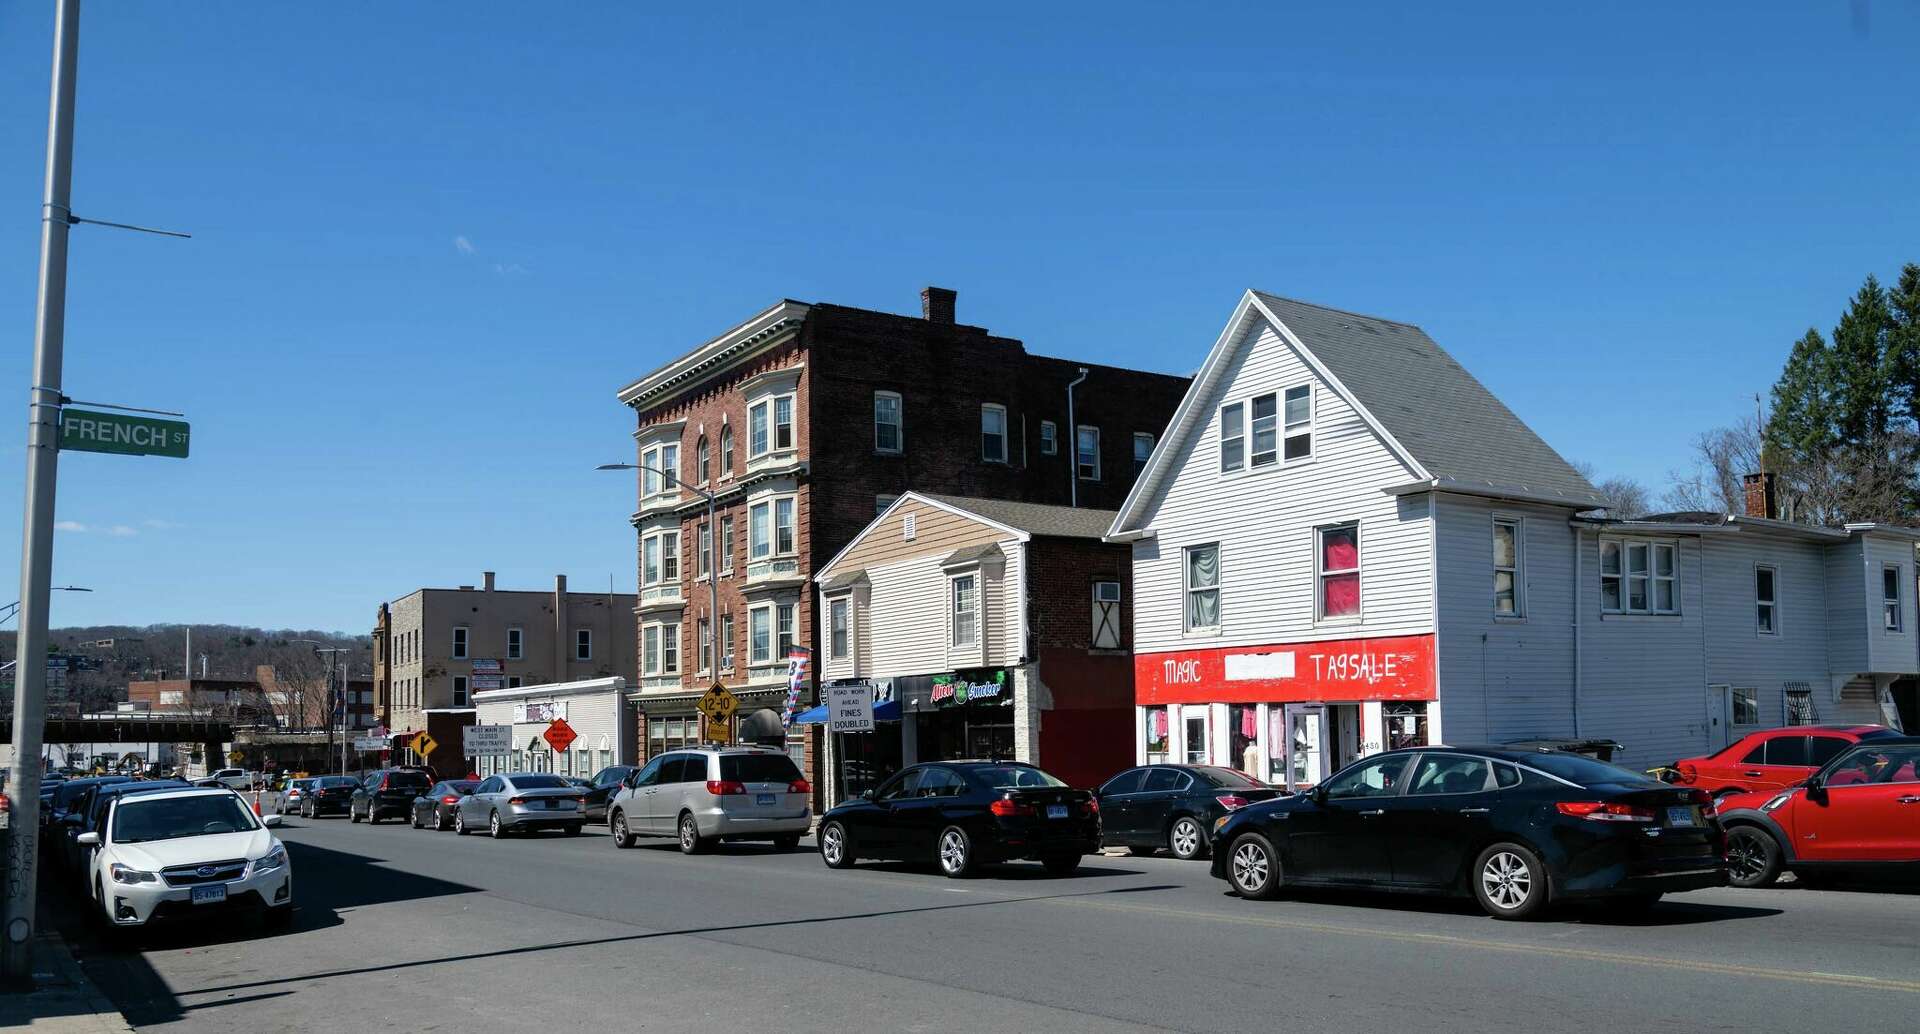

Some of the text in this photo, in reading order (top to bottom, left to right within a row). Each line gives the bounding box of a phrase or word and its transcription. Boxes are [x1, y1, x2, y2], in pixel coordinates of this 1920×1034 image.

[64, 418, 188, 448] FRENCH ST
[930, 681, 1000, 703] Alien Smoker
[840, 708, 862, 718] FINES
[835, 719, 869, 729] DOUBLED
